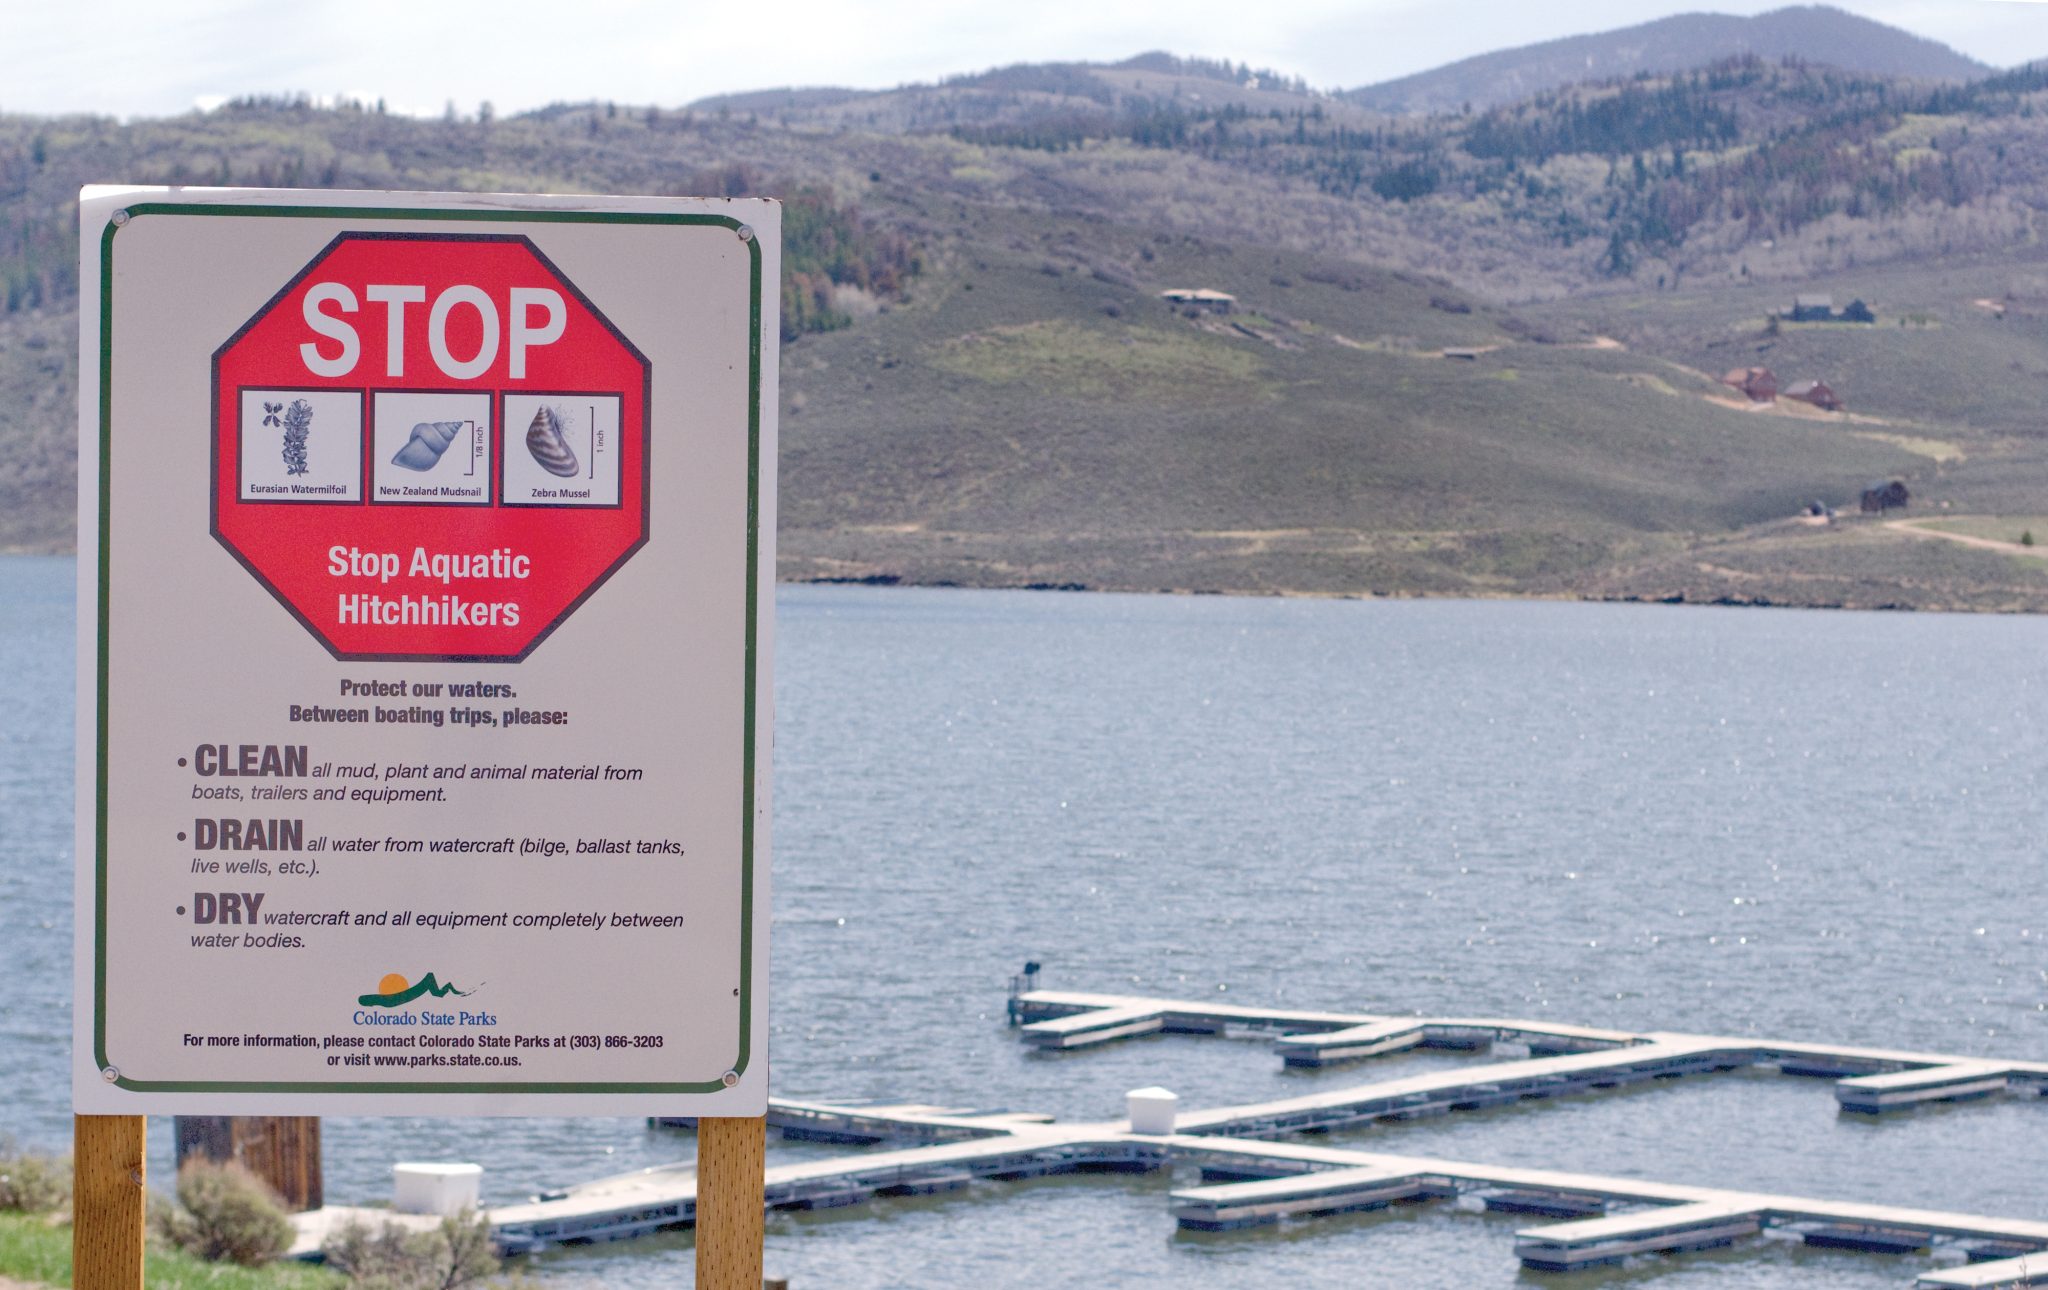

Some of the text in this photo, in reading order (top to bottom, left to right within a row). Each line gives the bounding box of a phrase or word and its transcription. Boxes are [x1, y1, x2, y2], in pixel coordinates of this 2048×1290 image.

[300, 282, 567, 379] STOP
[251, 484, 346, 494] Eurasian Watermilfoil
[380, 487, 481, 496] New Zealand Mudsnail
[532, 488, 590, 498] Zebra Mussel
[329, 546, 529, 584] Stop Aquatic
[339, 594, 519, 626] Hitchhikers
[341, 679, 516, 698] Protect our waters.
[290, 705, 567, 728] Between boating trips, please:
[195, 744, 642, 781] CLEAN all mud, plant and animal material from
[192, 784, 446, 804] boats, trailers and equipment.
[195, 819, 684, 856] DRAIN all water from watercraft (bilge, ballast tanks,
[191, 858, 319, 877] live wells, etc.).
[195, 893, 683, 930] DRY watercraft and all equipment completely between
[192, 933, 305, 947] water bodies.
[353, 1011, 496, 1025] Colorado State Parks
[184, 1034, 663, 1050] For more information, please contact Colorado State Parks at (303) 866-3203
[327, 1054, 521, 1068] or visit www.parks.state.co.us.
